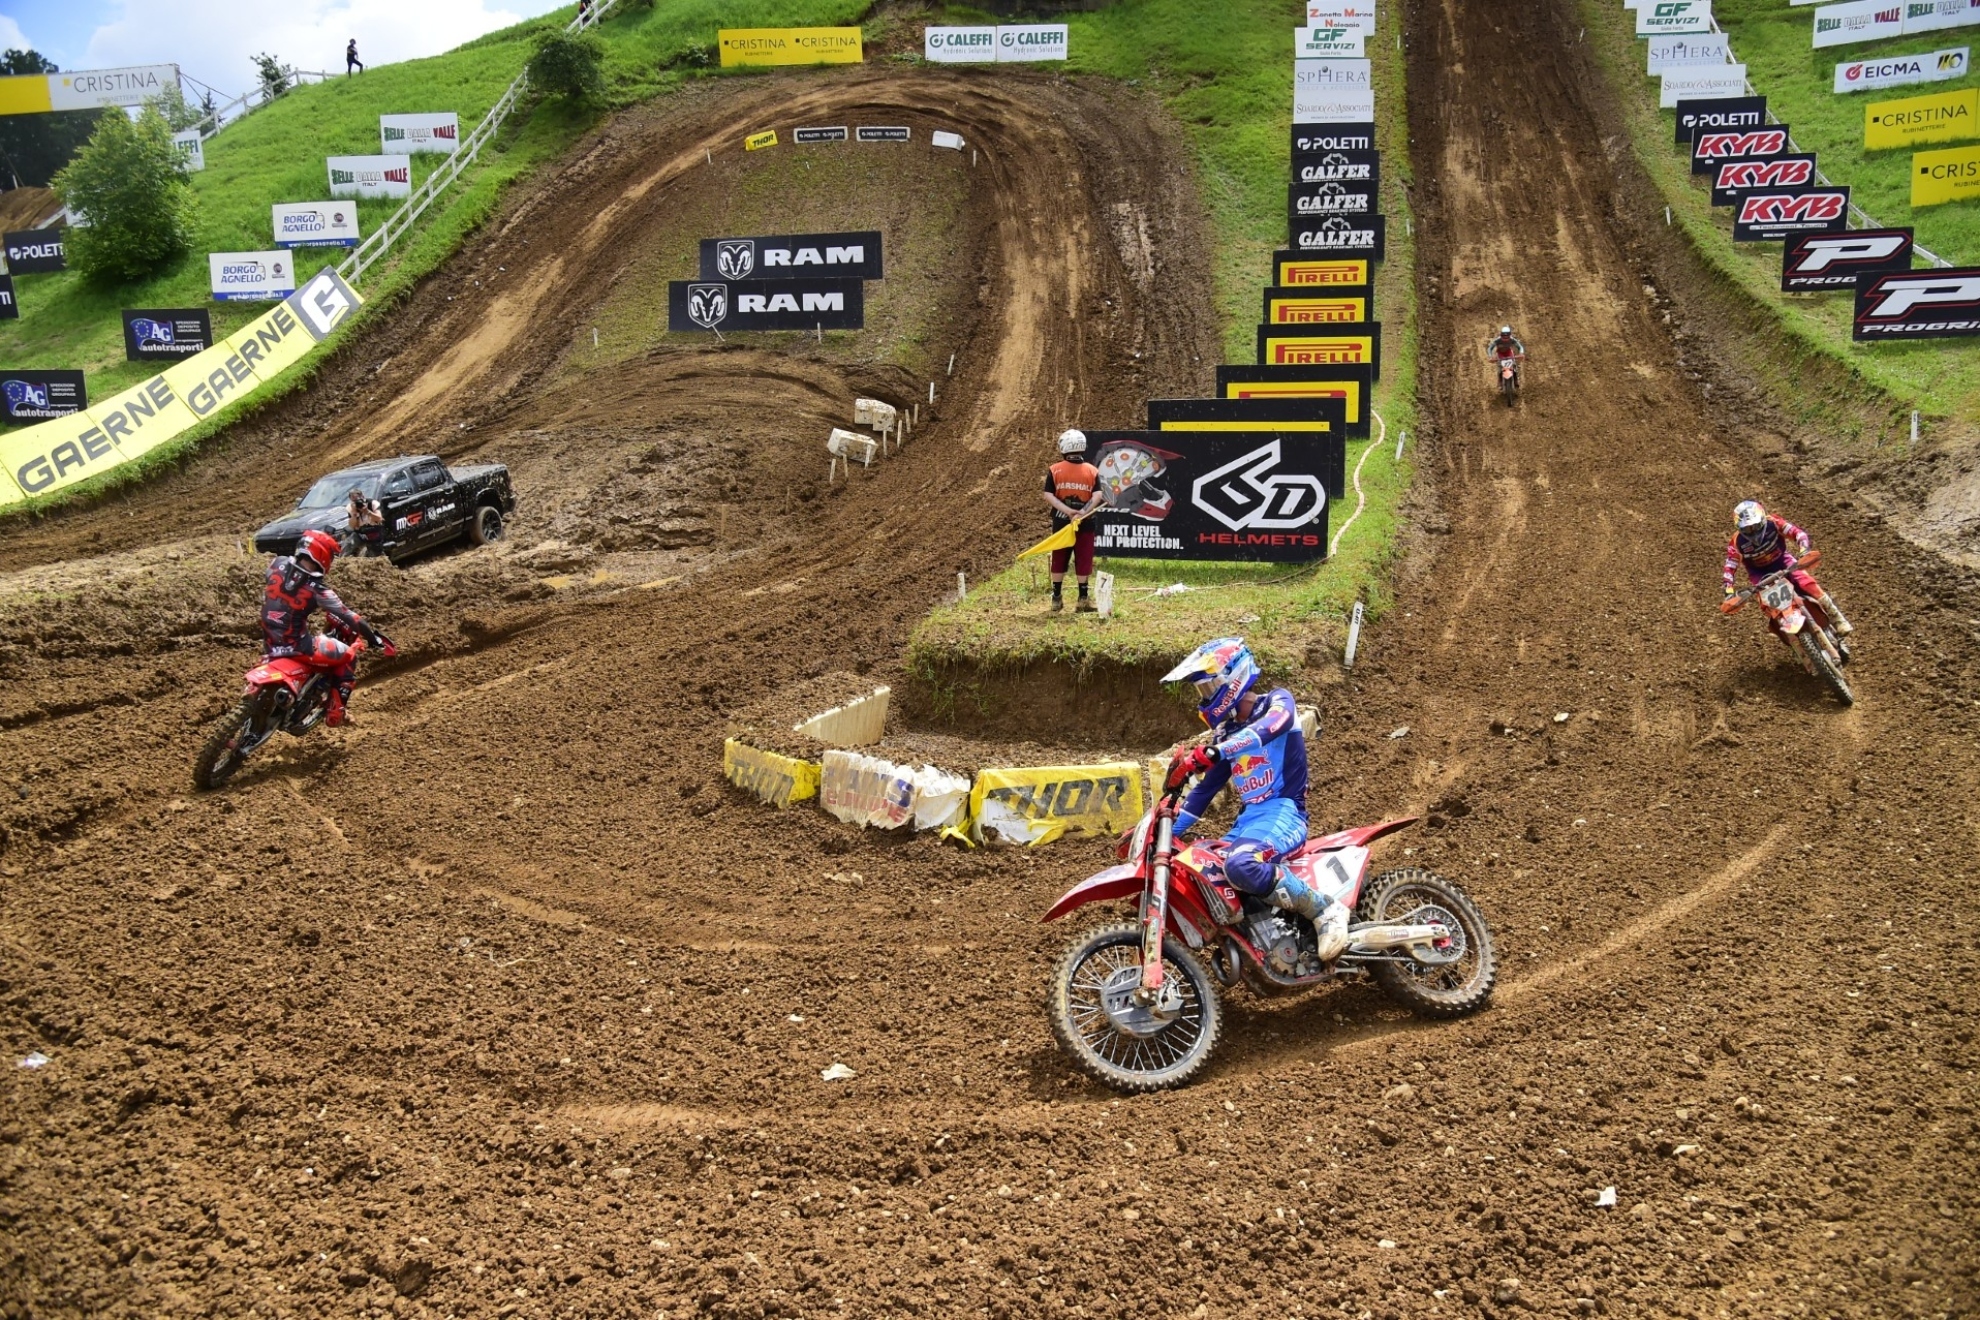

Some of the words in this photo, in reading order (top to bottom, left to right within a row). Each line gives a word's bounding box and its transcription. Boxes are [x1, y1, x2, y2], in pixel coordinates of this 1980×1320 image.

[1655, 2, 1692, 17] GF
[1907, 2, 1934, 19] SELLE
[1646, 16, 1700, 25] SERVIZI
[1817, 17, 1842, 33] SELLE
[1843, 14, 1871, 27] DALLA
[1874, 7, 1901, 23] VALLE
[730, 38, 786, 50] CRISTINA
[802, 36, 857, 47] CRISTINA
[946, 33, 992, 46] CALEFFI
[1017, 31, 1064, 45] CALEFFI
[1313, 28, 1347, 42] GF
[1305, 42, 1356, 50] SERVIZI
[1650, 44, 1723, 60] SPHERA
[1297, 68, 1367, 83] SPHERA
[1865, 61, 1921, 79] EICMA
[74, 72, 159, 93] CRISTINA
[1699, 111, 1759, 127] POLETTI
[1882, 103, 1968, 127] CRISTINA
[384, 126, 405, 142] SELLE
[433, 124, 456, 139] VALLE
[752, 134, 774, 147] THOR
[1313, 136, 1368, 150] POLETTI
[1695, 130, 1786, 158] KYB
[331, 169, 354, 185] SELLE
[384, 167, 408, 183] VALLE
[1301, 164, 1371, 180] GALFER
[1715, 159, 1813, 189] KYB
[1931, 161, 1980, 180] CRIS
[1296, 193, 1368, 210] GALFER
[1738, 192, 1846, 224] KYB
[283, 214, 316, 224] BORGO
[282, 223, 321, 233] AGNELLO
[1299, 229, 1375, 246] GALFER
[22, 243, 65, 260] POLETT
[764, 245, 864, 267] RAM
[222, 265, 257, 275] BORGO
[1287, 265, 1360, 284] PIRELLI
[220, 274, 262, 284] AGNELLO
[1789, 276, 1857, 286] PROG
[737, 292, 844, 313] RAM
[1278, 303, 1357, 322] PIRELLI
[151, 322, 171, 342] AG
[142, 343, 205, 353] autotrasporti
[1275, 343, 1363, 364] PIRELLI
[187, 306, 297, 416] GAERNE
[24, 385, 46, 406] AG
[14, 407, 79, 419] autotrasporti
[17, 374, 176, 493] GAERNE
[436, 502, 456, 514] RAM
[1103, 524, 1130, 536] NEXT
[1132, 524, 1162, 537] LEVEL
[1198, 532, 1319, 546] HELMETS
[1116, 536, 1184, 550] PROTECTION.
[1101, 577, 1107, 588] 7
[1767, 585, 1792, 608] 84
[1212, 696, 1231, 717] Red
[1226, 675, 1243, 700] Bull
[1249, 768, 1274, 789] Bull
[984, 775, 1130, 819] THOR
[1325, 855, 1350, 884] 1
